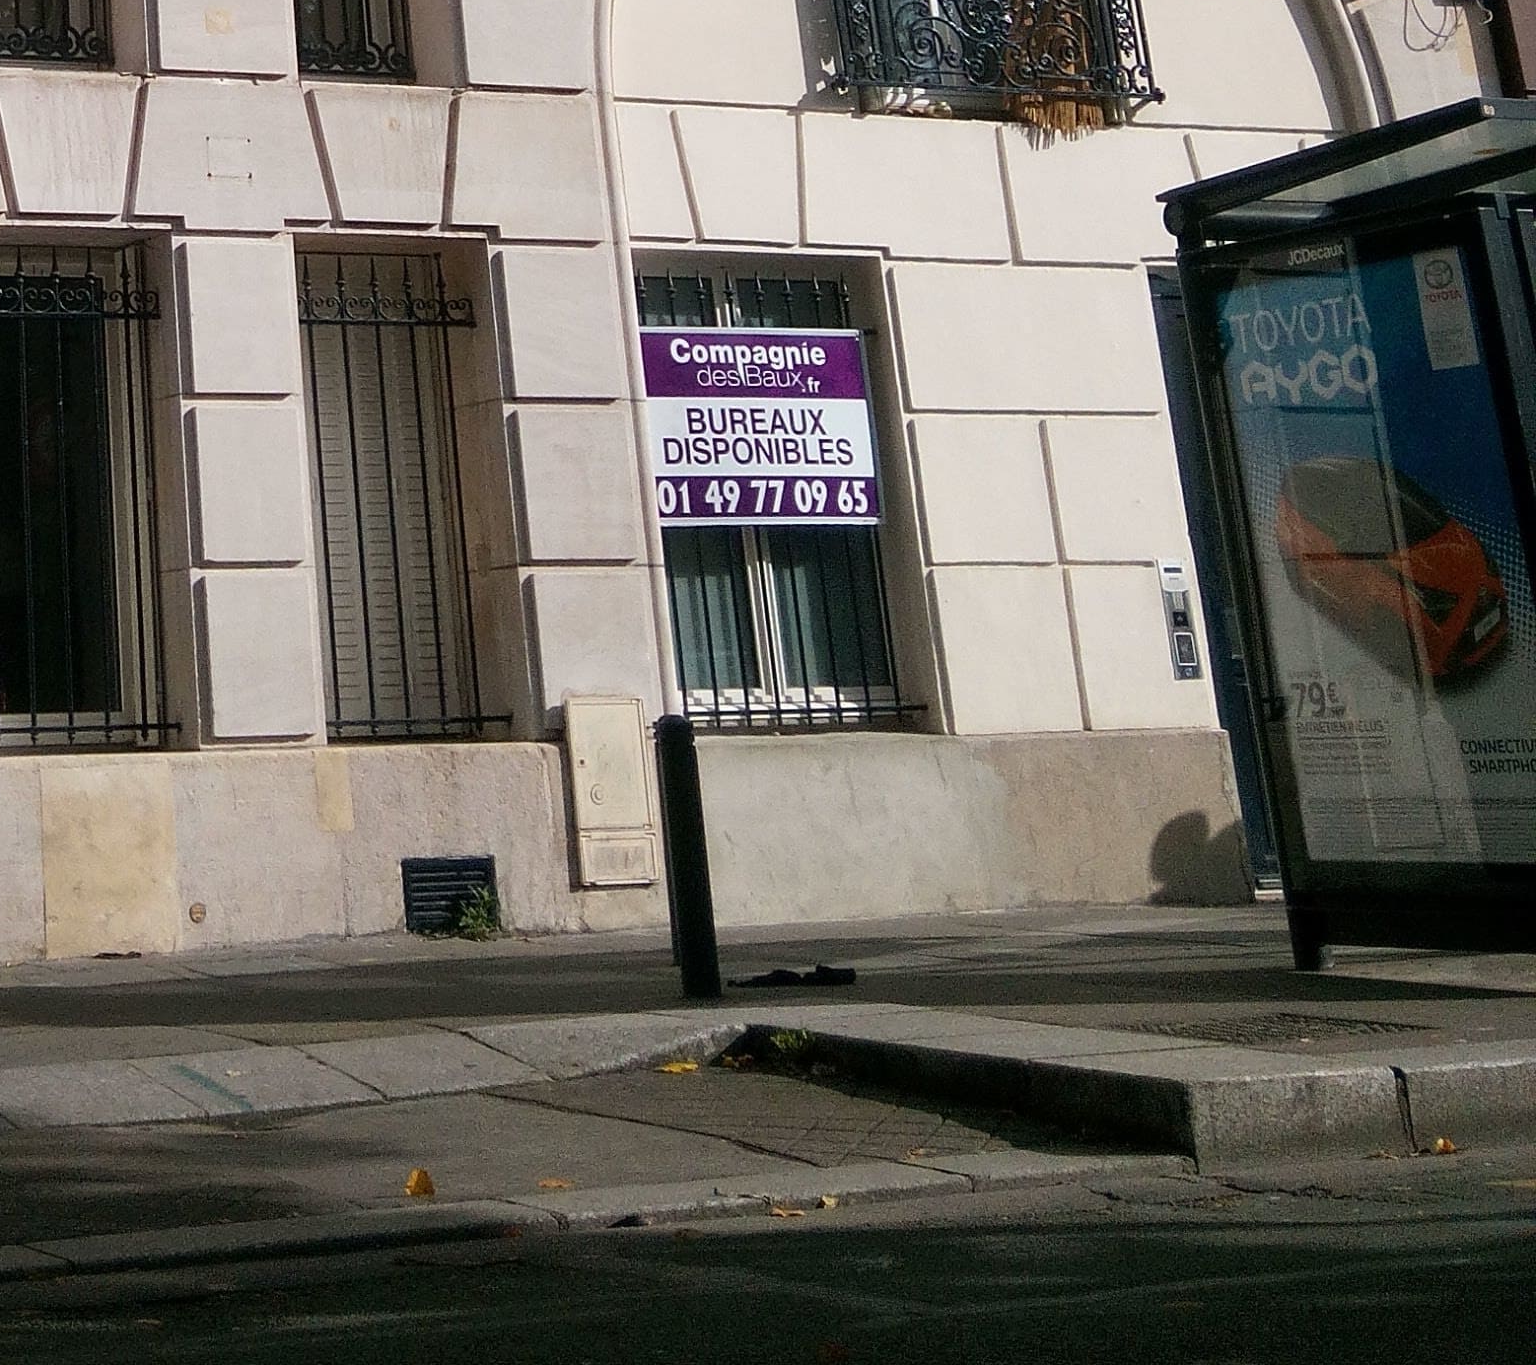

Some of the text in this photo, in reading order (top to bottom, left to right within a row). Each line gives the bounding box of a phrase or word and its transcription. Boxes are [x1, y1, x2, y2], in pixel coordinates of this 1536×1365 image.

[1287, 244, 1346, 267] JCDecaux
[1229, 293, 1372, 354] TOYOTA
[669, 338, 827, 377] Compagnie
[1240, 343, 1379, 405] AYGO
[685, 407, 827, 436] BUREAUX
[662, 436, 854, 466] DISPONIBLES
[656, 479, 869, 515] 01 49 77 09 65
